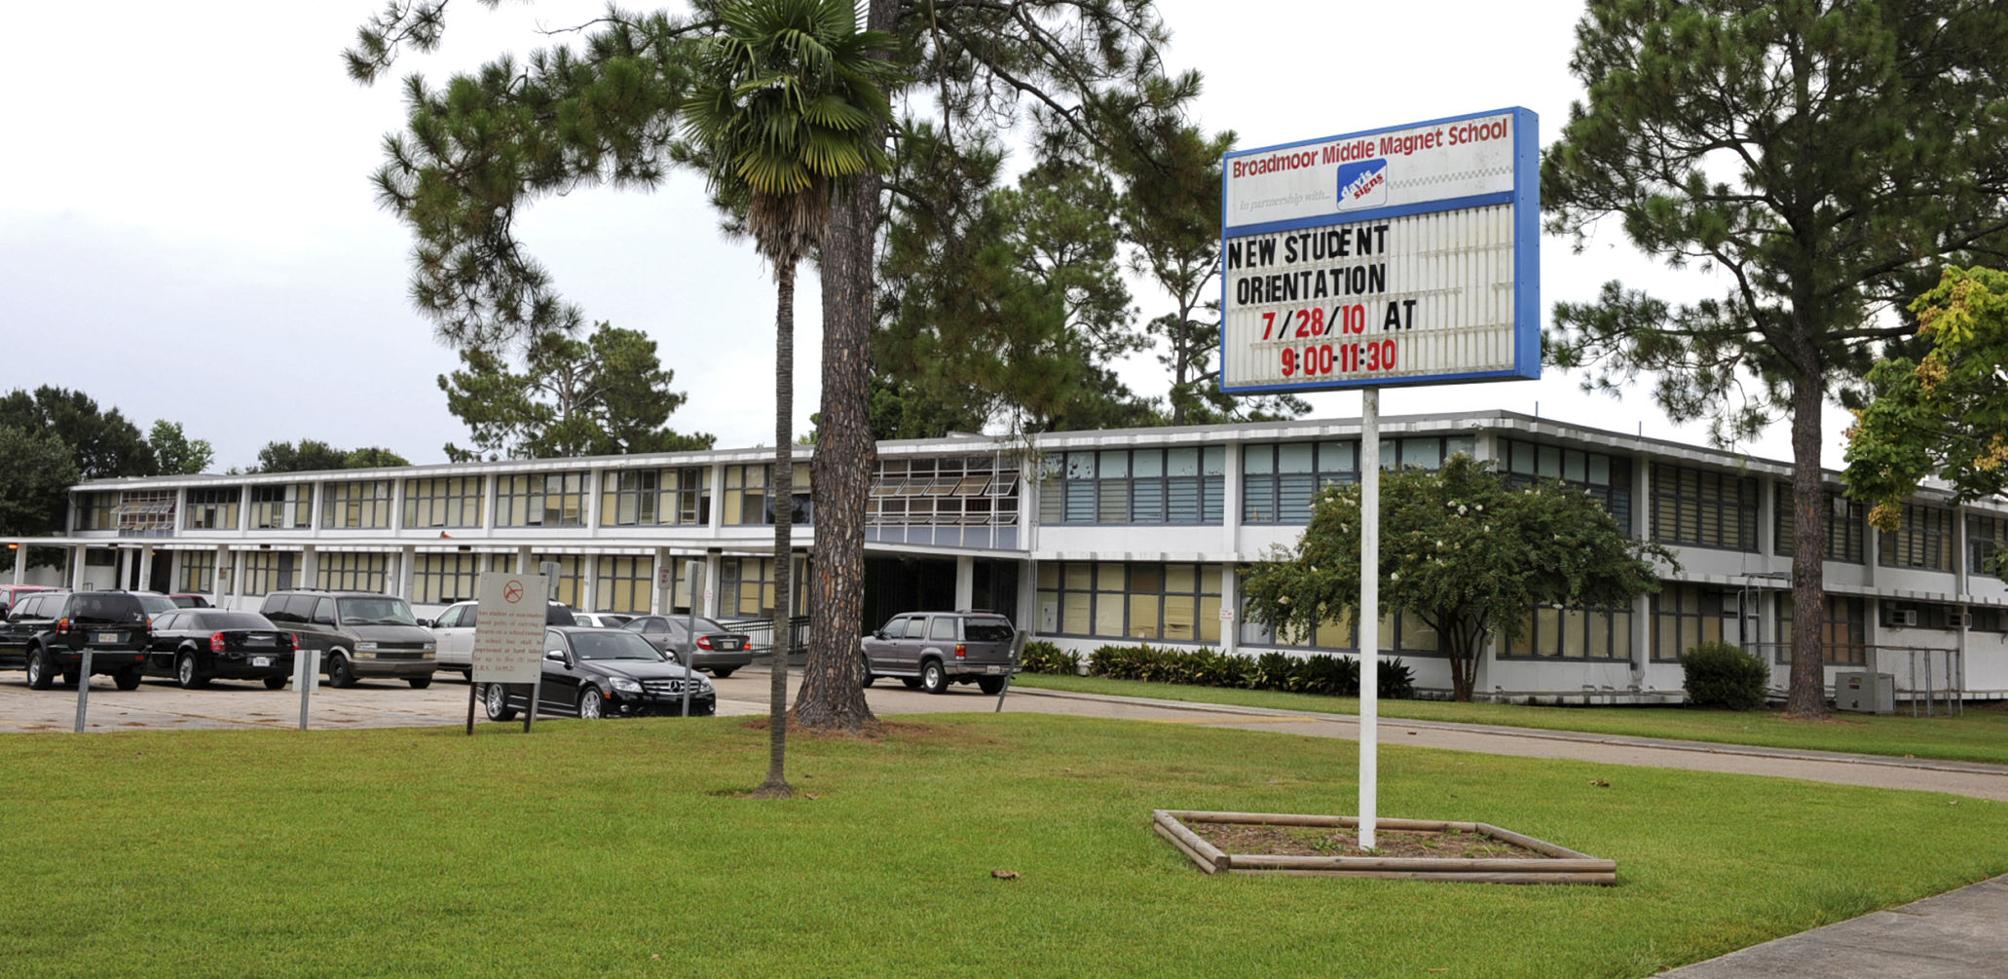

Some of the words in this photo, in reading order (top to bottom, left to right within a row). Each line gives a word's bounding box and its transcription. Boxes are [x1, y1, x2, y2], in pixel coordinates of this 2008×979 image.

[1232, 150, 1318, 178] Broadmoor
[1322, 140, 1375, 165] Middle
[1379, 127, 1443, 156] Magnet
[1449, 118, 1507, 145] School
[1354, 173, 1383, 200] signs
[1228, 238, 1276, 270] NEW
[1284, 225, 1389, 264] STUDENT
[1237, 263, 1386, 305] ORIENTATION
[1262, 304, 1365, 340] 7/28/10
[1383, 300, 1417, 330] AT
